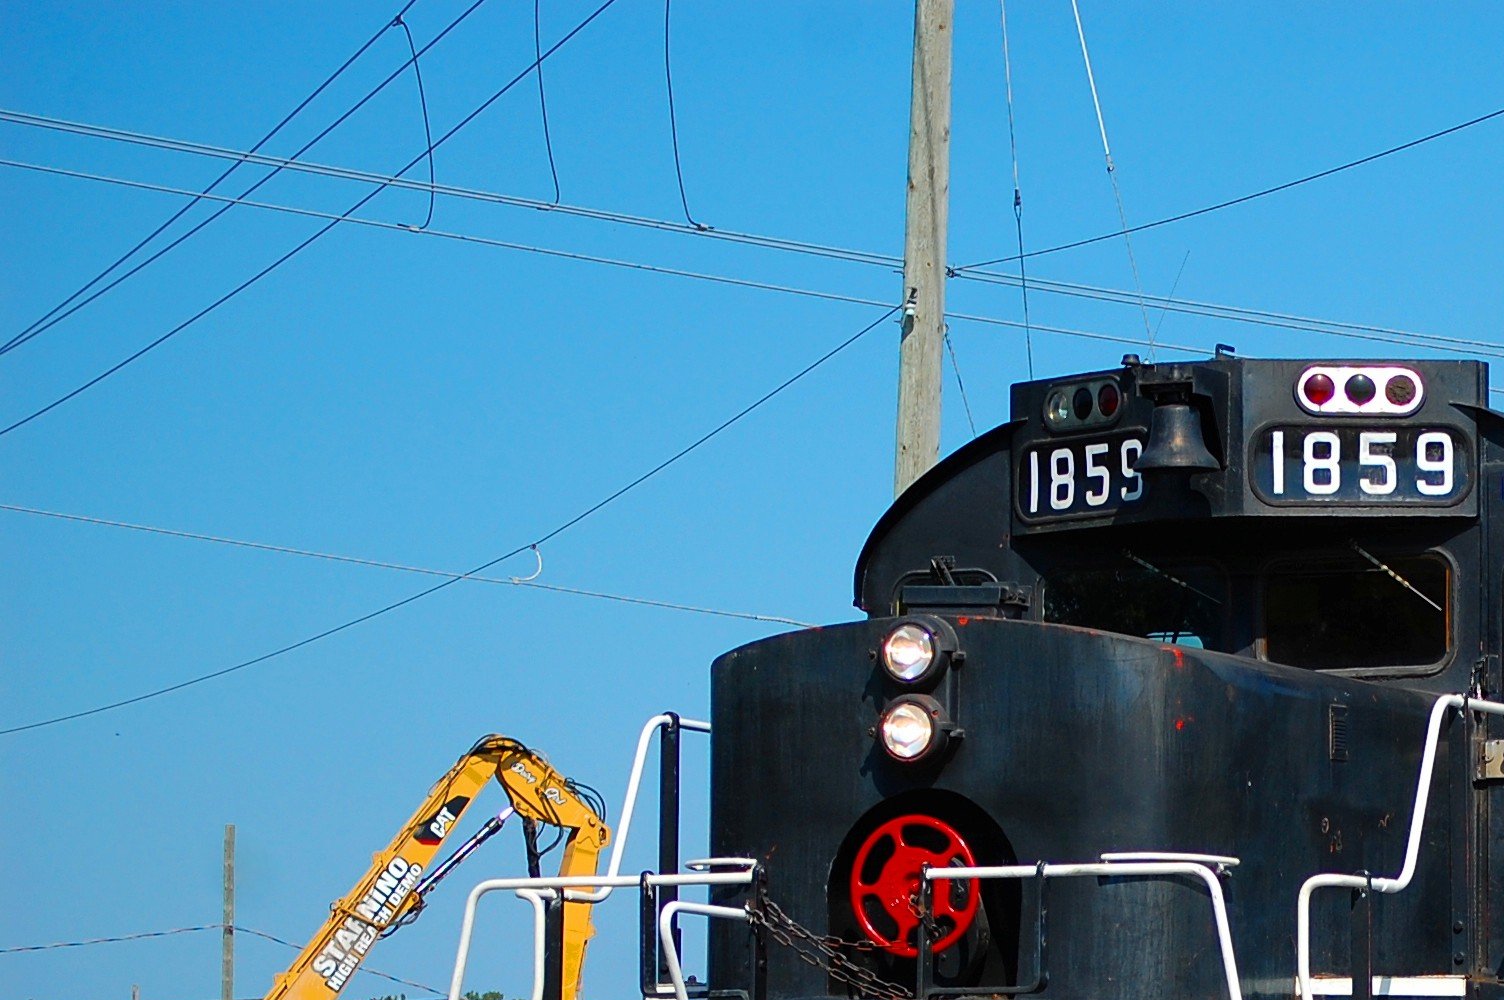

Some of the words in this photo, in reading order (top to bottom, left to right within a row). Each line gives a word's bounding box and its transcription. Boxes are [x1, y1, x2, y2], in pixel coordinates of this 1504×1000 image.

[1030, 439, 1143, 513] 1859
[1272, 430, 1454, 496] 1859
[430, 806, 456, 839] CAT
[326, 952, 360, 992] HIGH
[389, 863, 423, 909] DEMO
